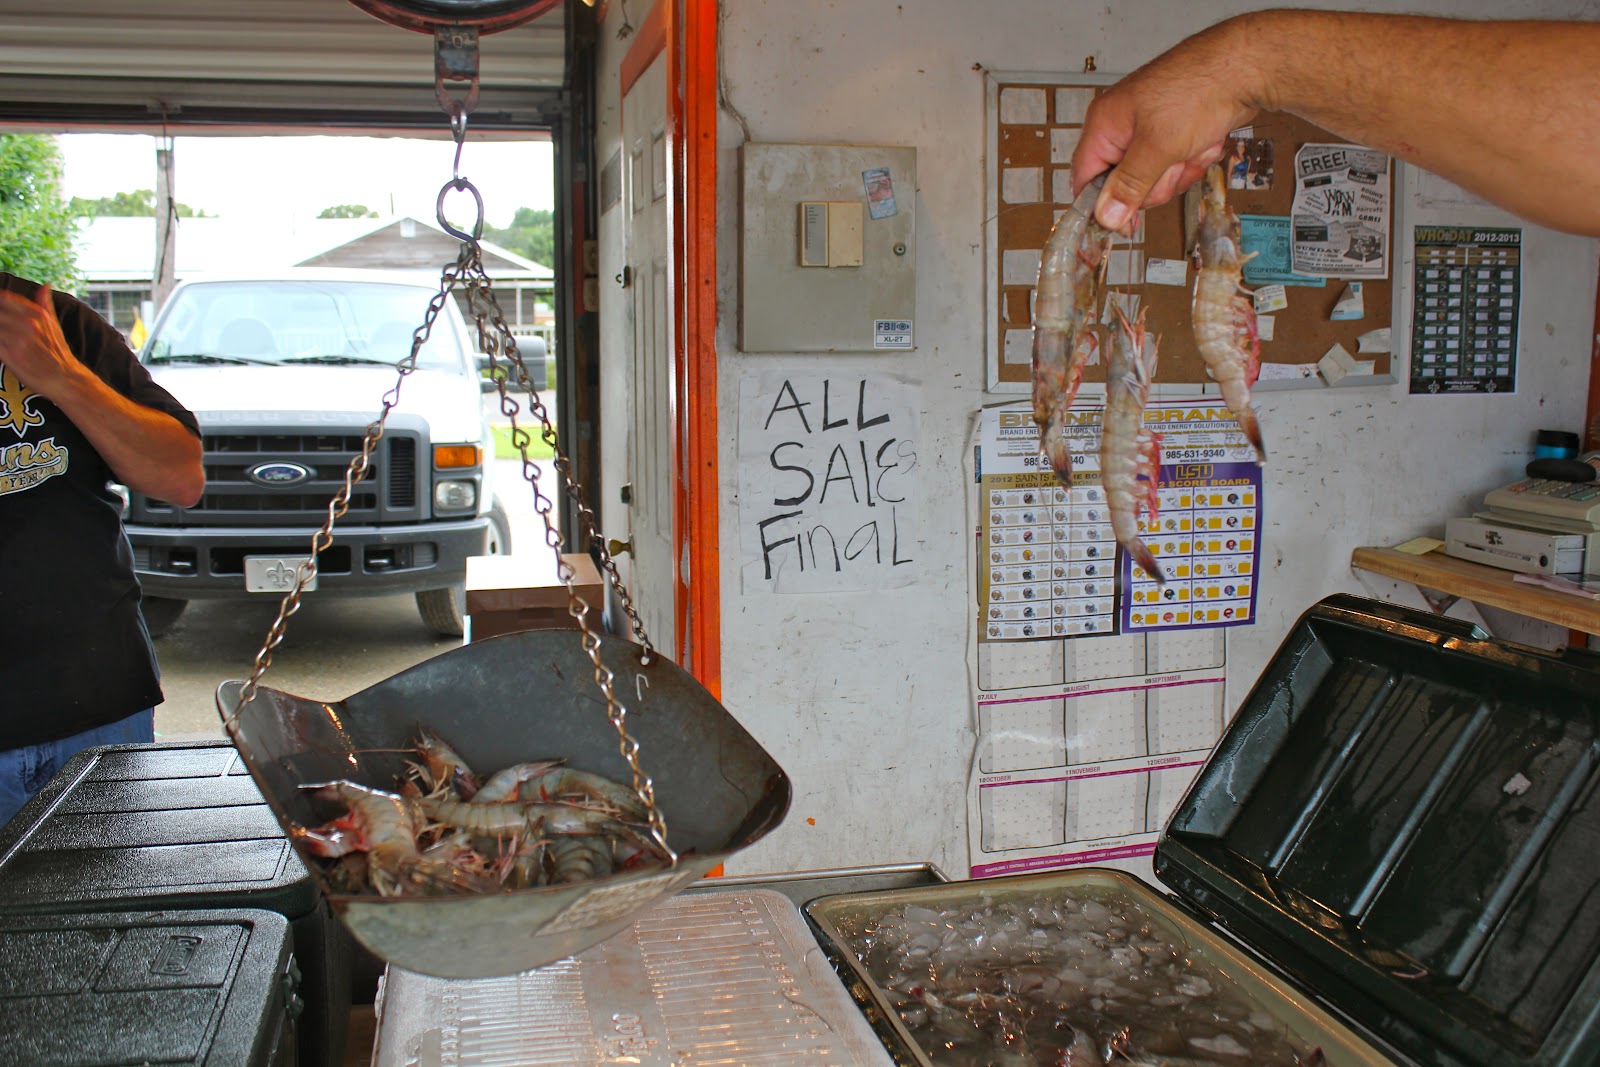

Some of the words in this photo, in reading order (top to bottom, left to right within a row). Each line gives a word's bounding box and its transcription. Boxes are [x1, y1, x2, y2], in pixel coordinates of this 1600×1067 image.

[1301, 151, 1348, 174] FREE!
[1415, 229, 1444, 241] WHO
[1450, 229, 1474, 241] DAT
[1474, 232, 1520, 242] 2012-2013
[1246, 266, 1289, 274] OCCUPATIONAL
[764, 378, 890, 434] ALL
[1167, 422, 1192, 430] ENERGY
[1000, 428, 1024, 436] BRAND
[1165, 449, 1225, 460] 985-631-9340
[1175, 464, 1214, 480] LSU
[990, 476, 1013, 484] 2012
[1015, 473, 1050, 483] SAINTS
[1168, 479, 1208, 489] SCORE
[1210, 478, 1251, 488] BOARD
